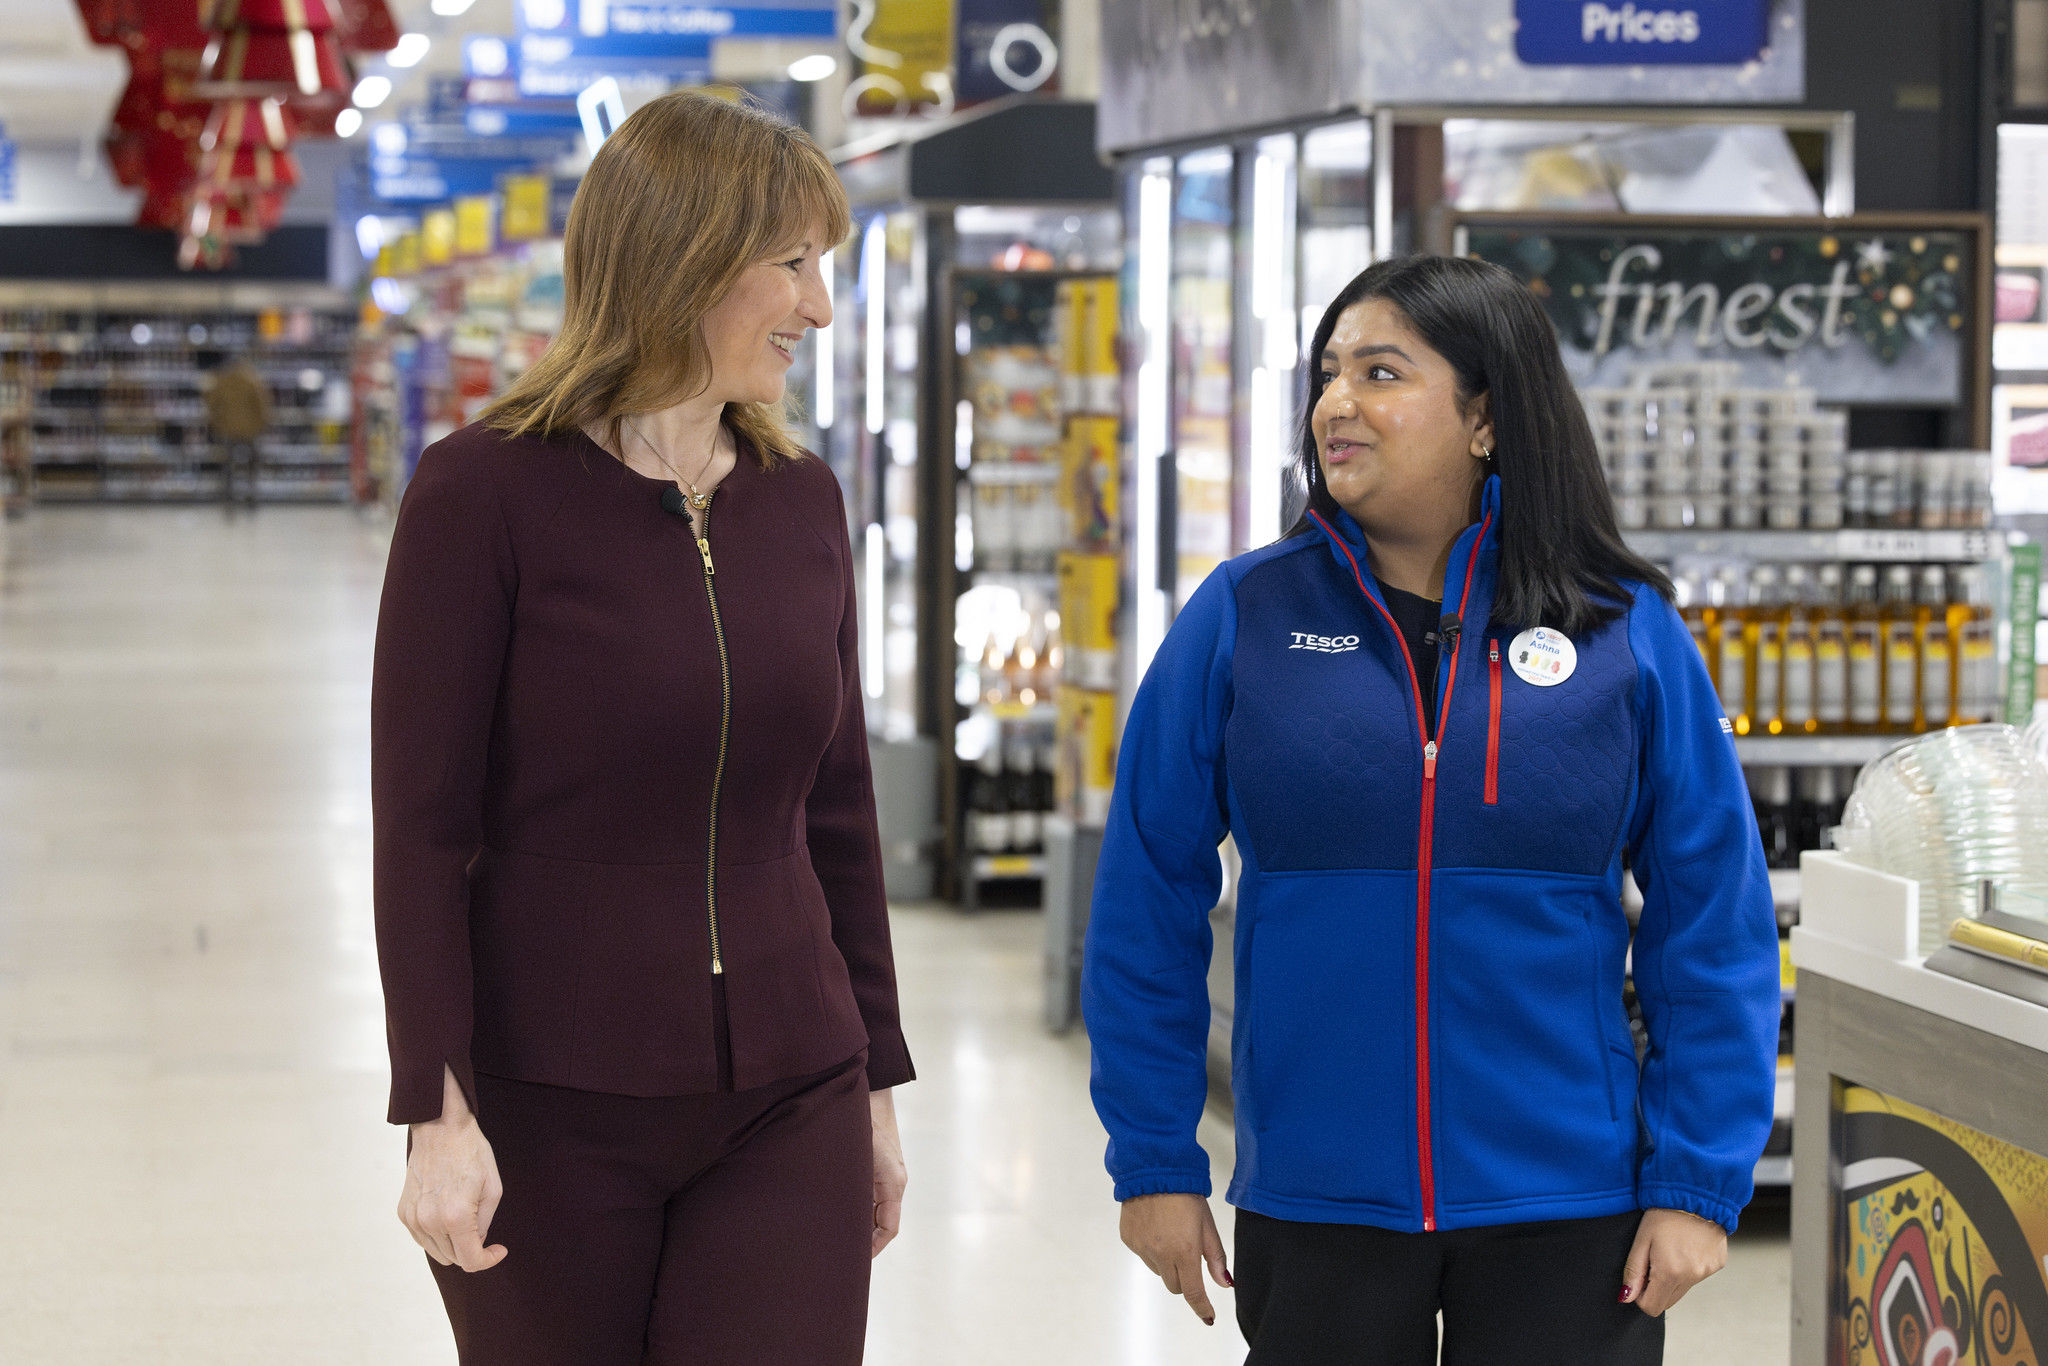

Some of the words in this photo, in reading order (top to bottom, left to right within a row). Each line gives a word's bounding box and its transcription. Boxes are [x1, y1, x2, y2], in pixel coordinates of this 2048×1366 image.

[1581, 1, 1700, 43] Prices
[1594, 244, 1861, 353] finest
[1290, 632, 1360, 648] TESCO
[1530, 640, 1560, 654] Ashna
